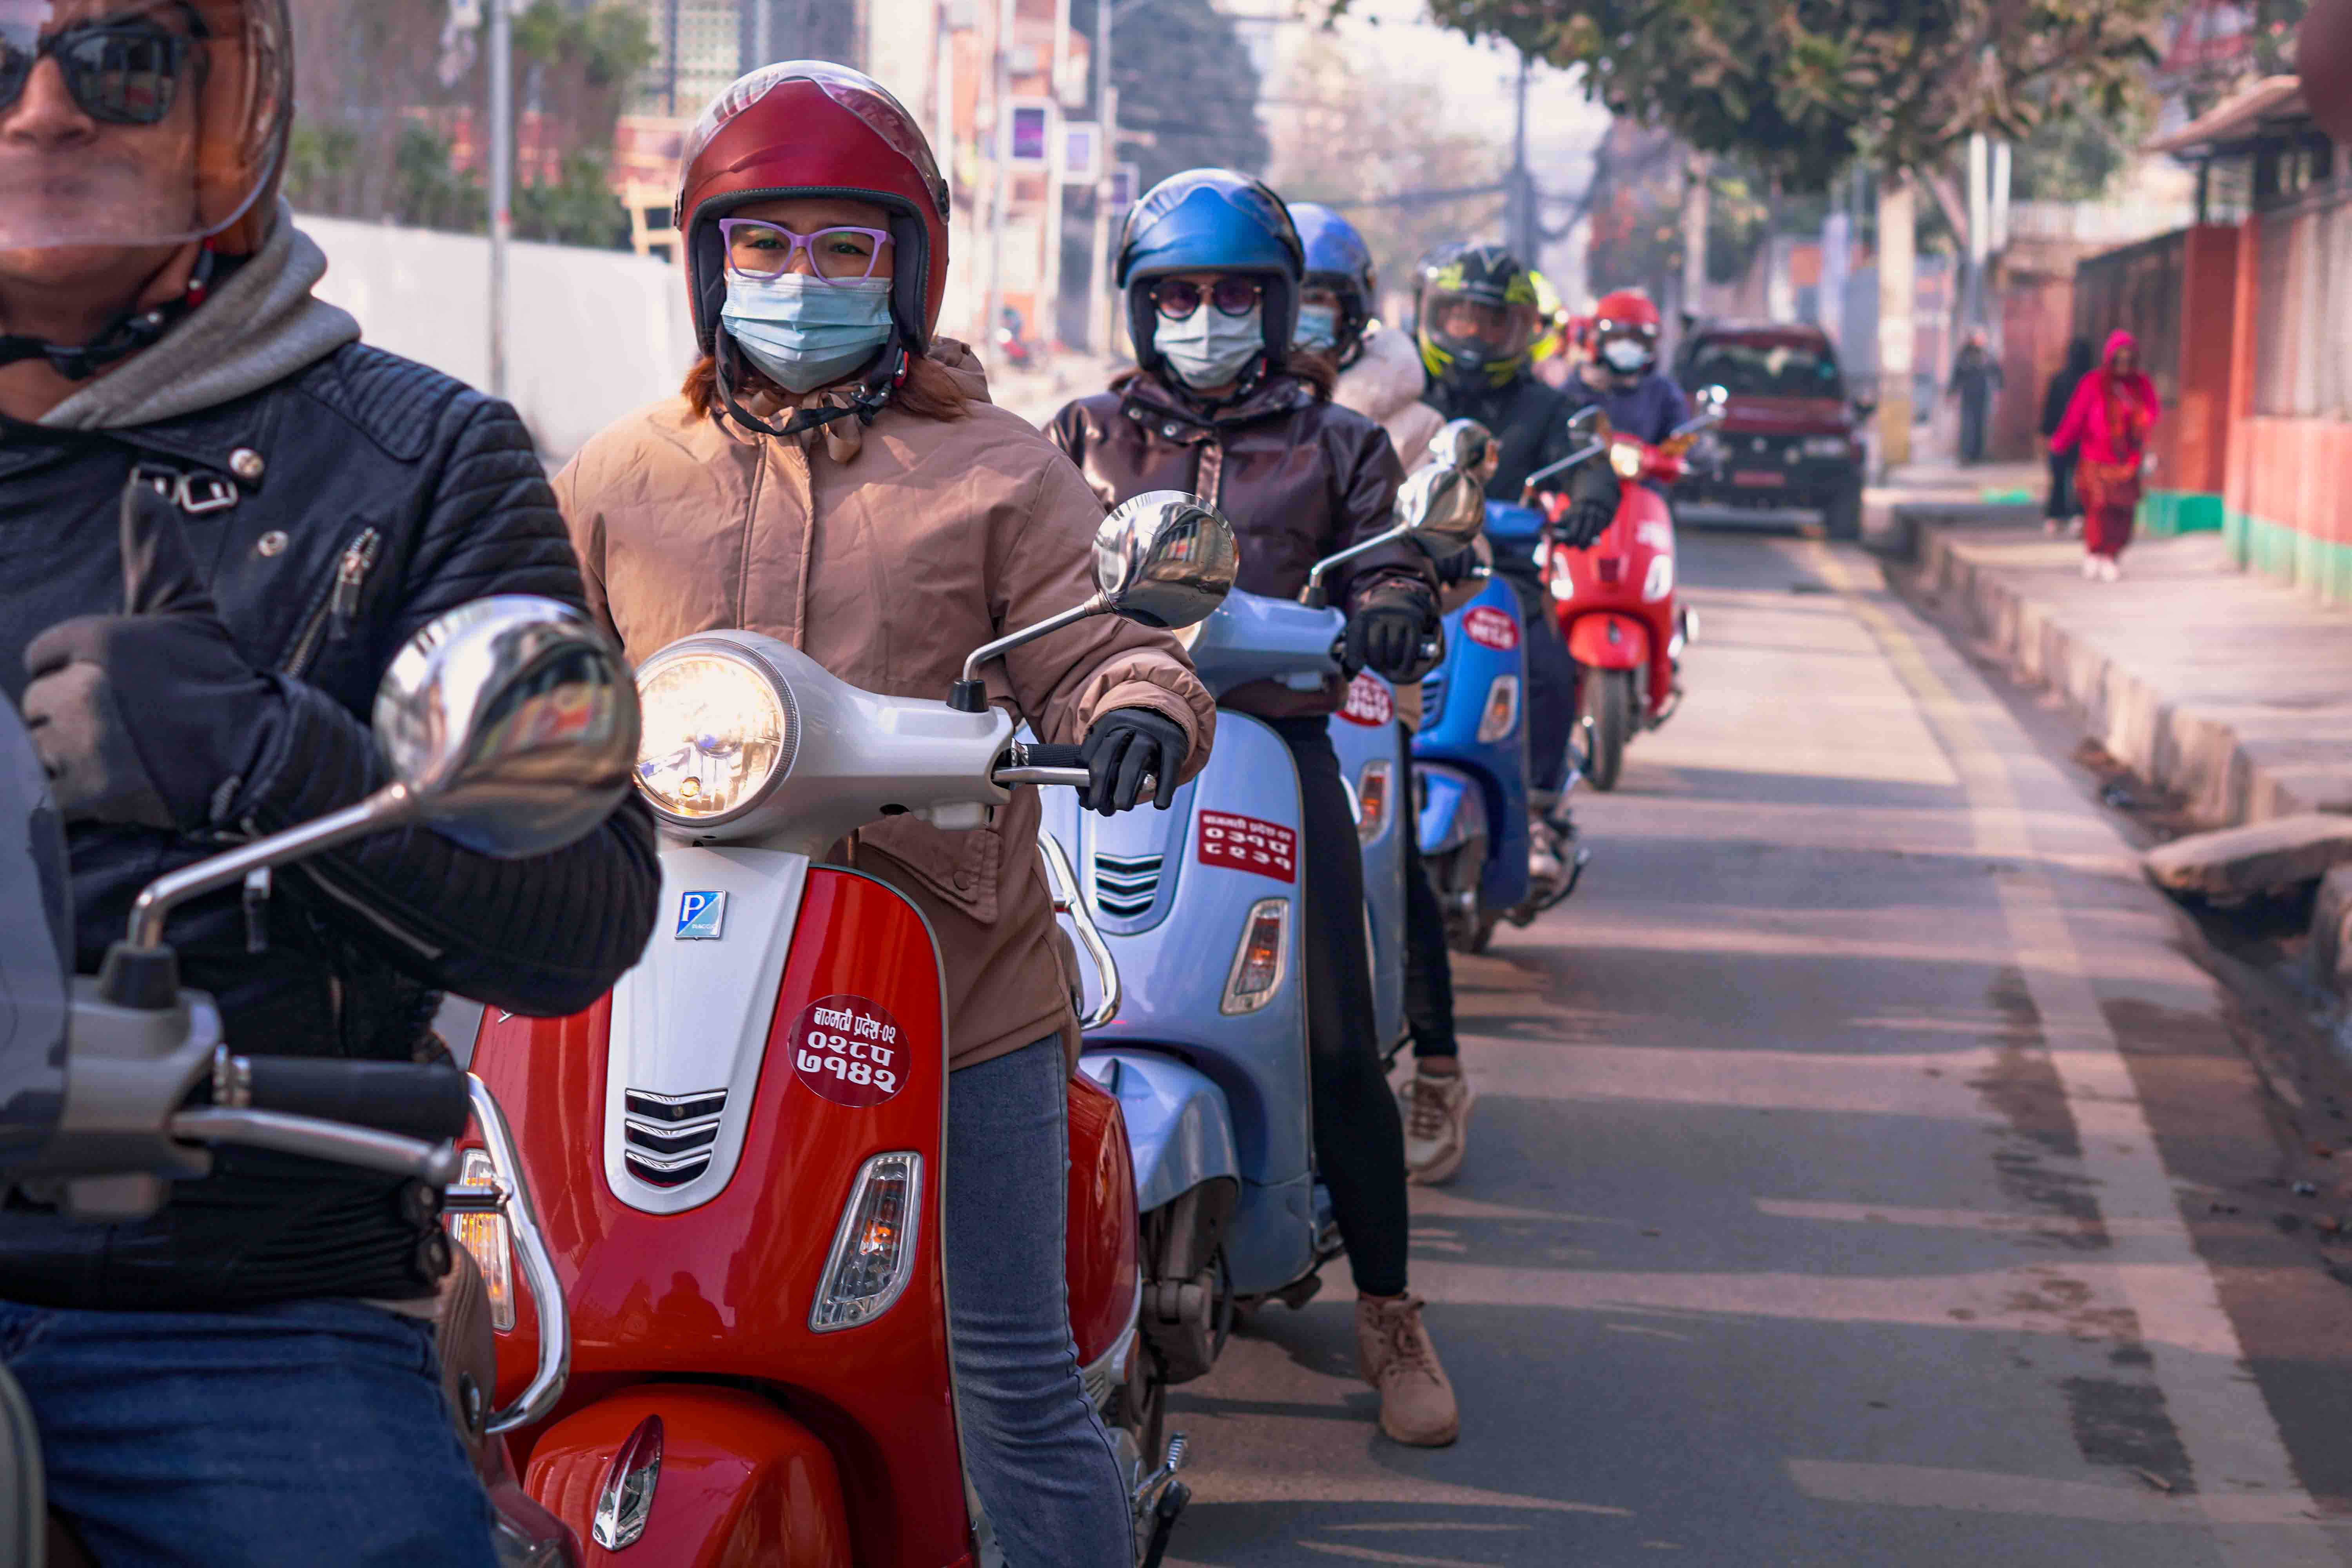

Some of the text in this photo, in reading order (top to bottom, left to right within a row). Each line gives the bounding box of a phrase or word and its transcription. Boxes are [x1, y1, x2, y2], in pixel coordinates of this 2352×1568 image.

[681, 895, 705, 922] P
[808, 1031, 895, 1067] ०२८प
[797, 1049, 896, 1093] ७१४२
